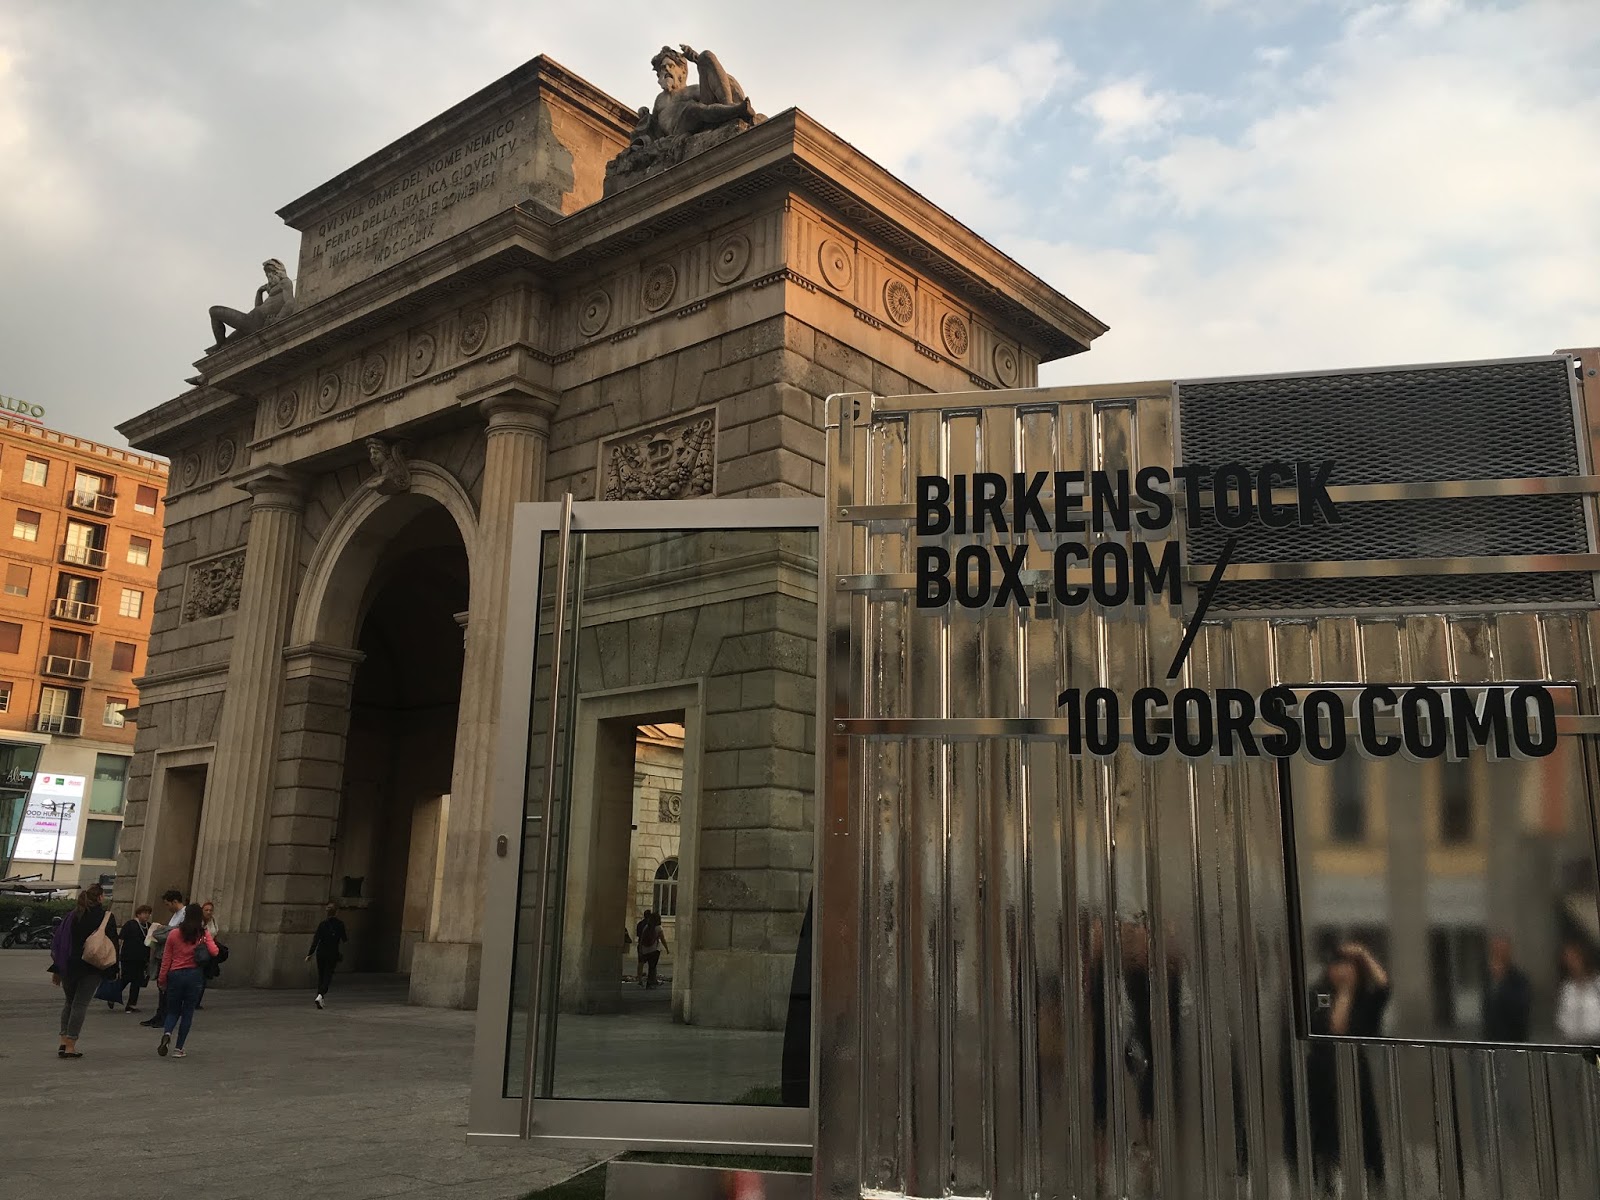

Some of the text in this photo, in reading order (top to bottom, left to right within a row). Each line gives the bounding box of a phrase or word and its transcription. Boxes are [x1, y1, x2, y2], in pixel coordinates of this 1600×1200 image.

[313, 138, 517, 258] IL FERRO DELLA ITALICA GIOVENTV
[319, 217, 337, 238] QVI
[368, 183, 399, 209] ORME
[402, 171, 422, 191] DEL
[427, 148, 461, 177] NOME
[465, 120, 514, 156] NEMICO
[329, 241, 362, 269] INCISE
[365, 233, 378, 250] LE
[916, 460, 1342, 536] BIRKENSTOCK
[916, 540, 1182, 609] BOX.COM
[1058, 685, 1557, 761] 10 CORSO COMO
